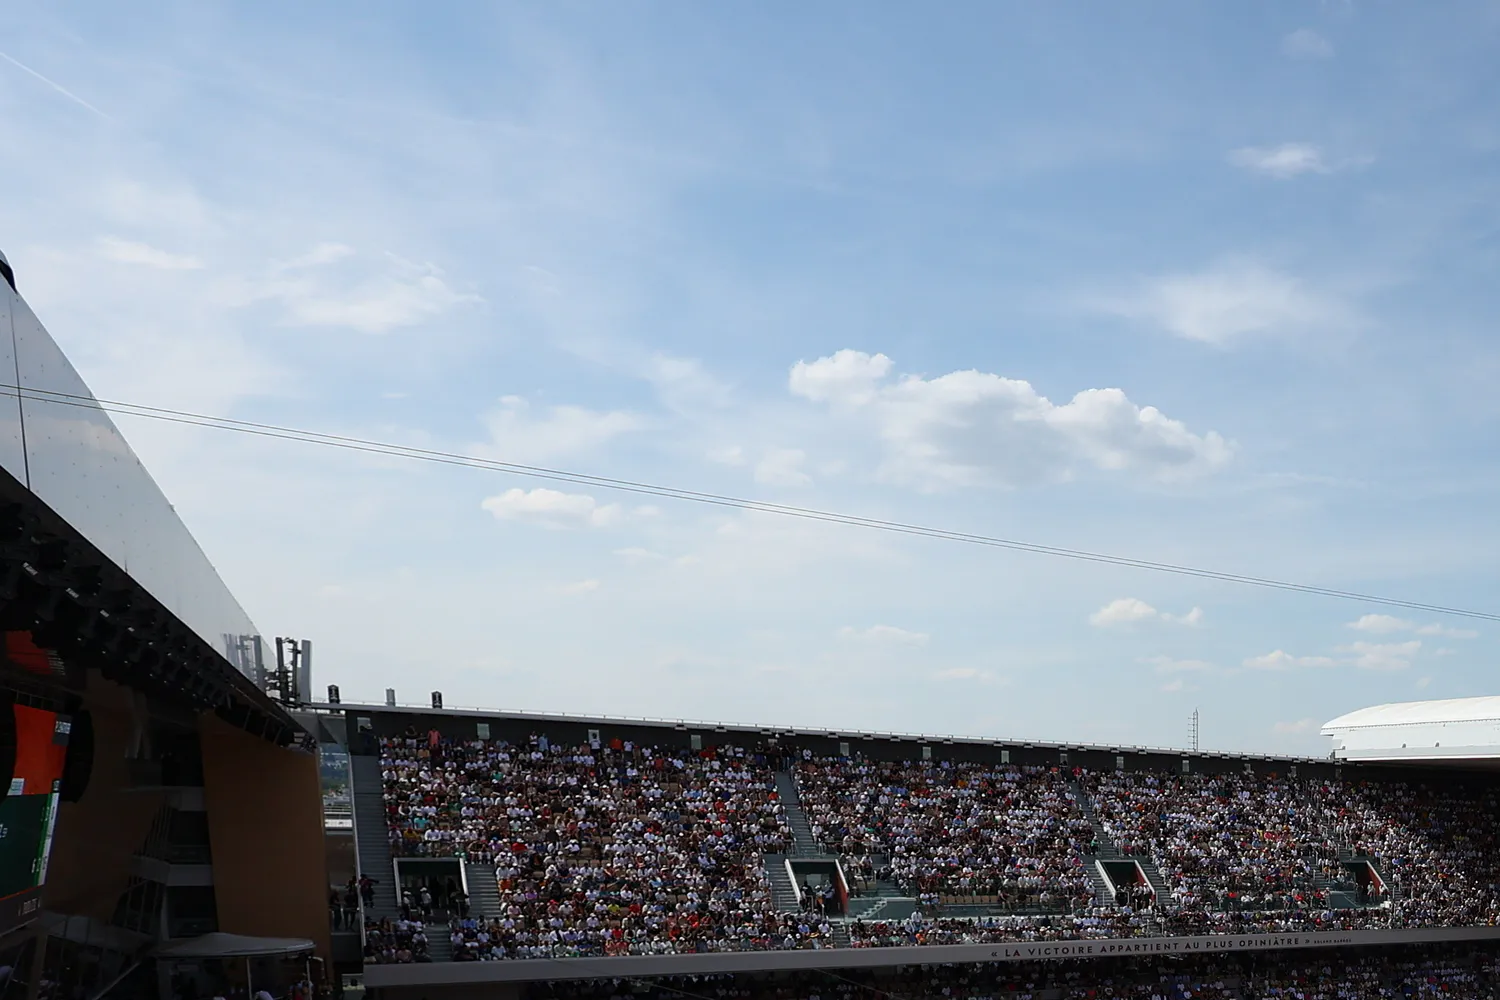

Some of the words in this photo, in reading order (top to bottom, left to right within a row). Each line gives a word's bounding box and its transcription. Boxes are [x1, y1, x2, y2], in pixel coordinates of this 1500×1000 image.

[1005, 949, 1020, 957] LA
[1027, 946, 1093, 956] VICTOIRE
[1100, 943, 1178, 953] APPARTIENT
[1206, 940, 1233, 948] PLUS
